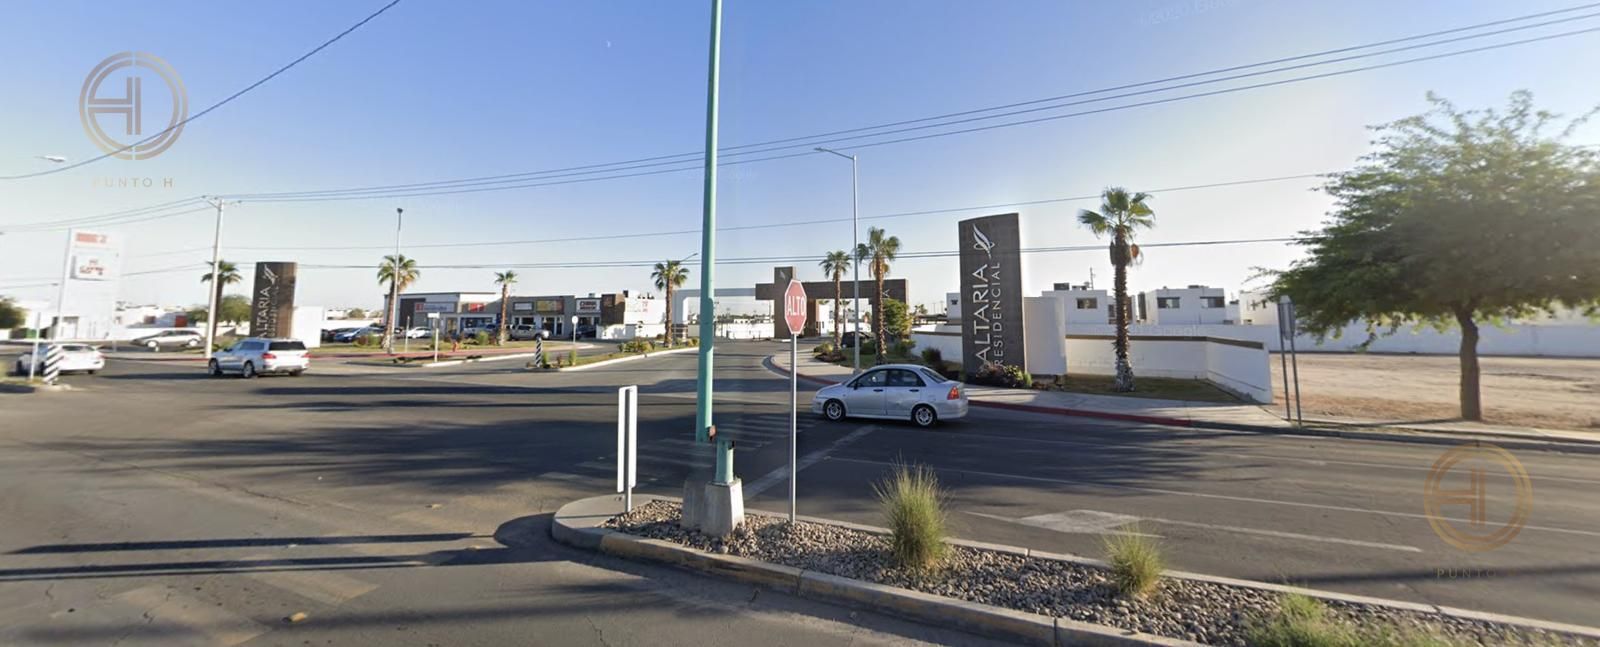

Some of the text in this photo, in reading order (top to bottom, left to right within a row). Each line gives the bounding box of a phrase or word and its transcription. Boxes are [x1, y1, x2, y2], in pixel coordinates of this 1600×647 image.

[787, 295, 805, 316] ALTO
[972, 263, 991, 370] ALTARIA
[991, 262, 1004, 367] RESIDENCIAL
